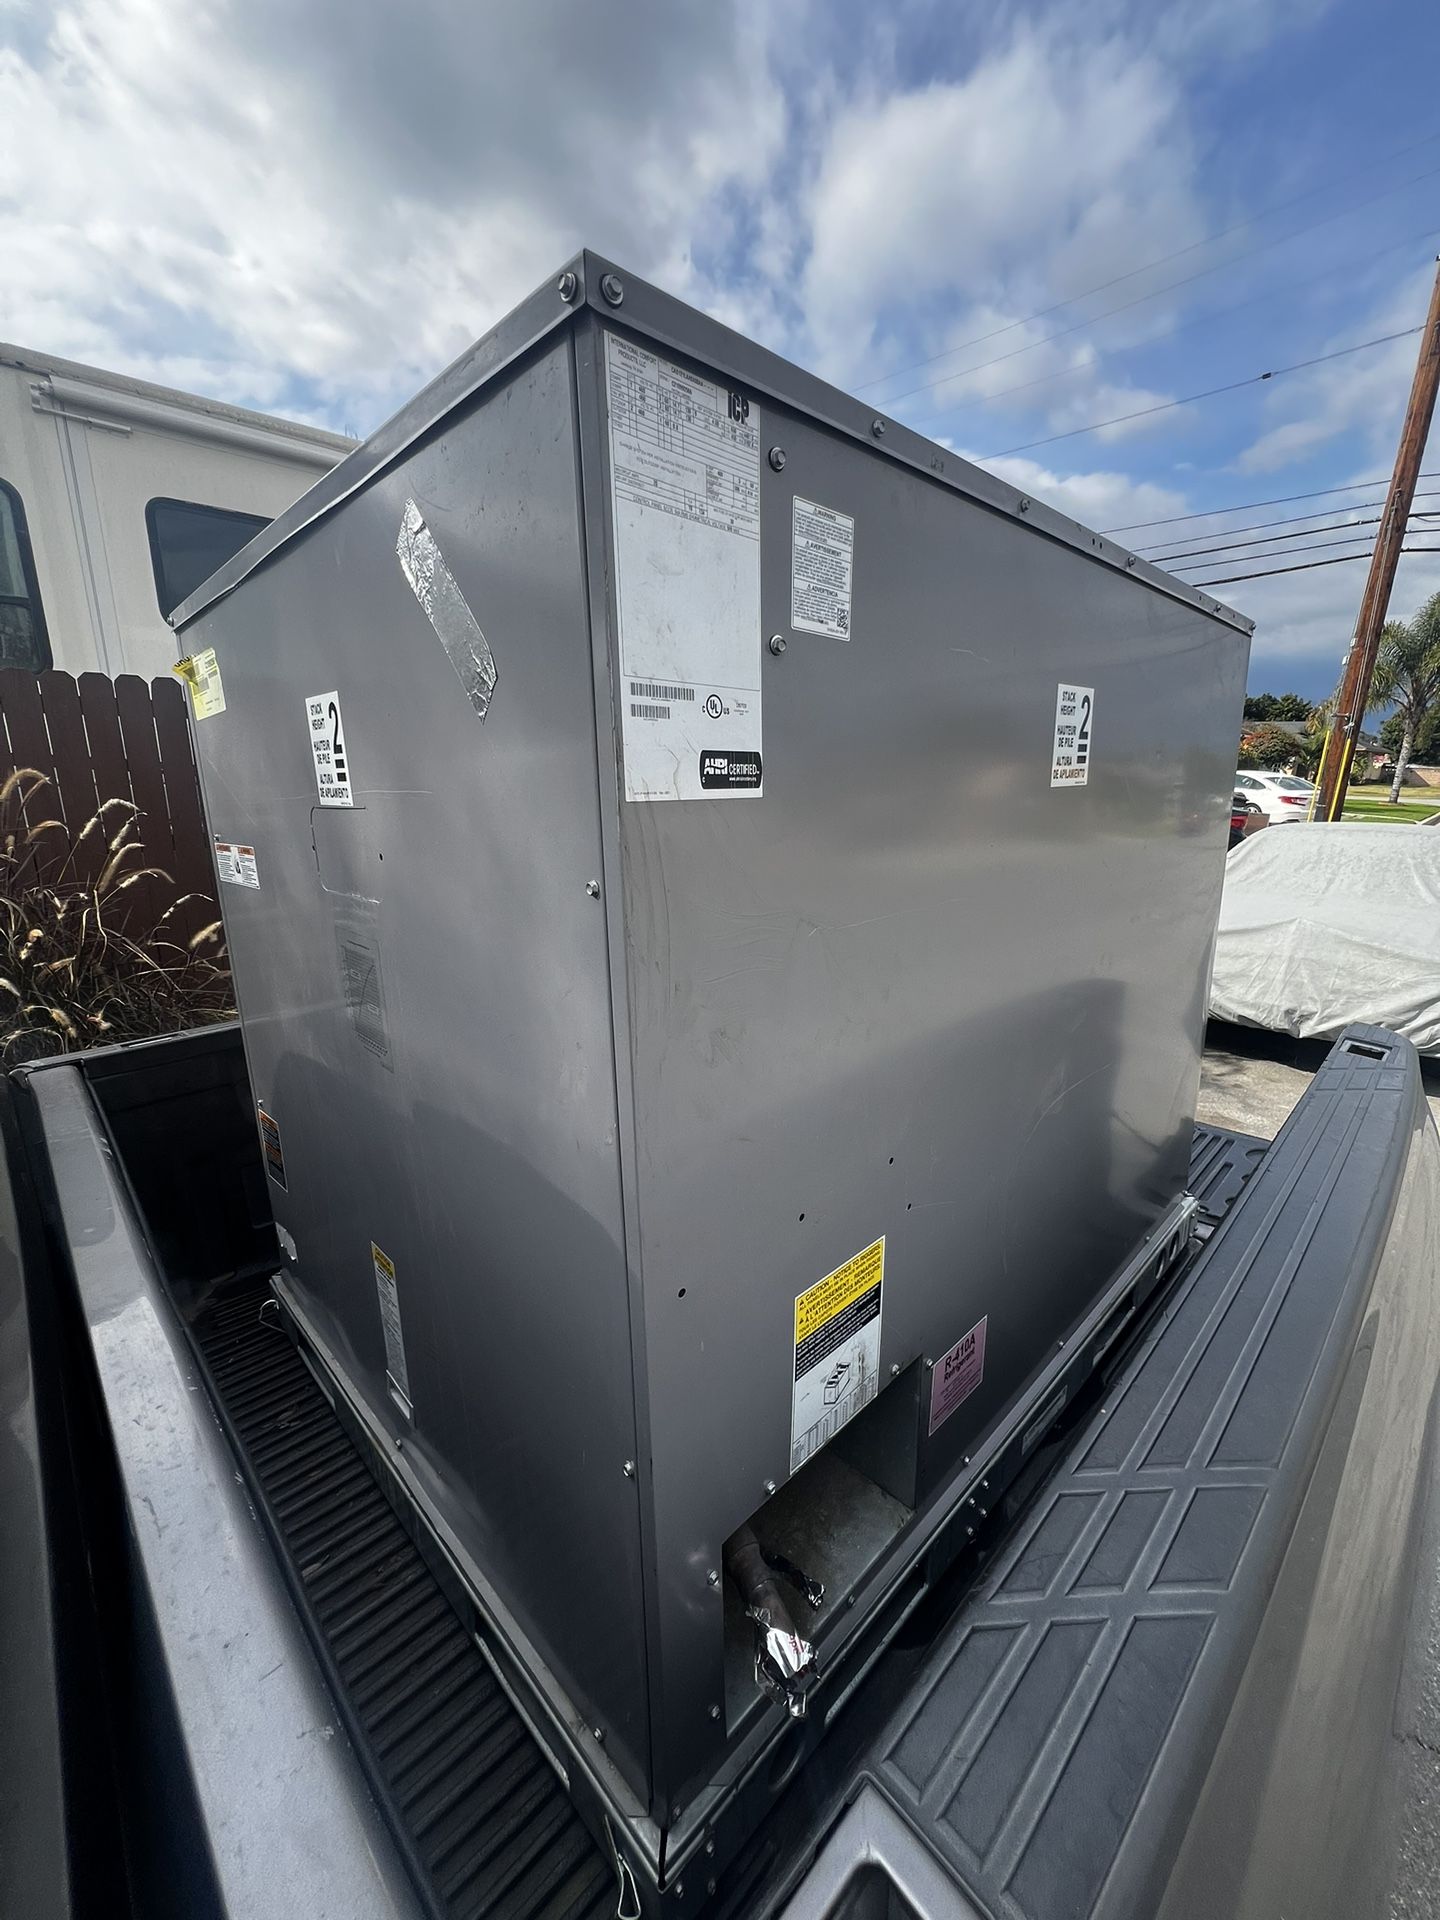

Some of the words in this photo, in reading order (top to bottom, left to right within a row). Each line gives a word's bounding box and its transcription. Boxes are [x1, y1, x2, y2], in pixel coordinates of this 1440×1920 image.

[728, 393, 750, 424] ICP
[328, 702, 343, 754] 2
[1079, 695, 1091, 740] 2
[806, 1280, 829, 1301] CAUTION
[944, 1333, 976, 1373] R-410A
